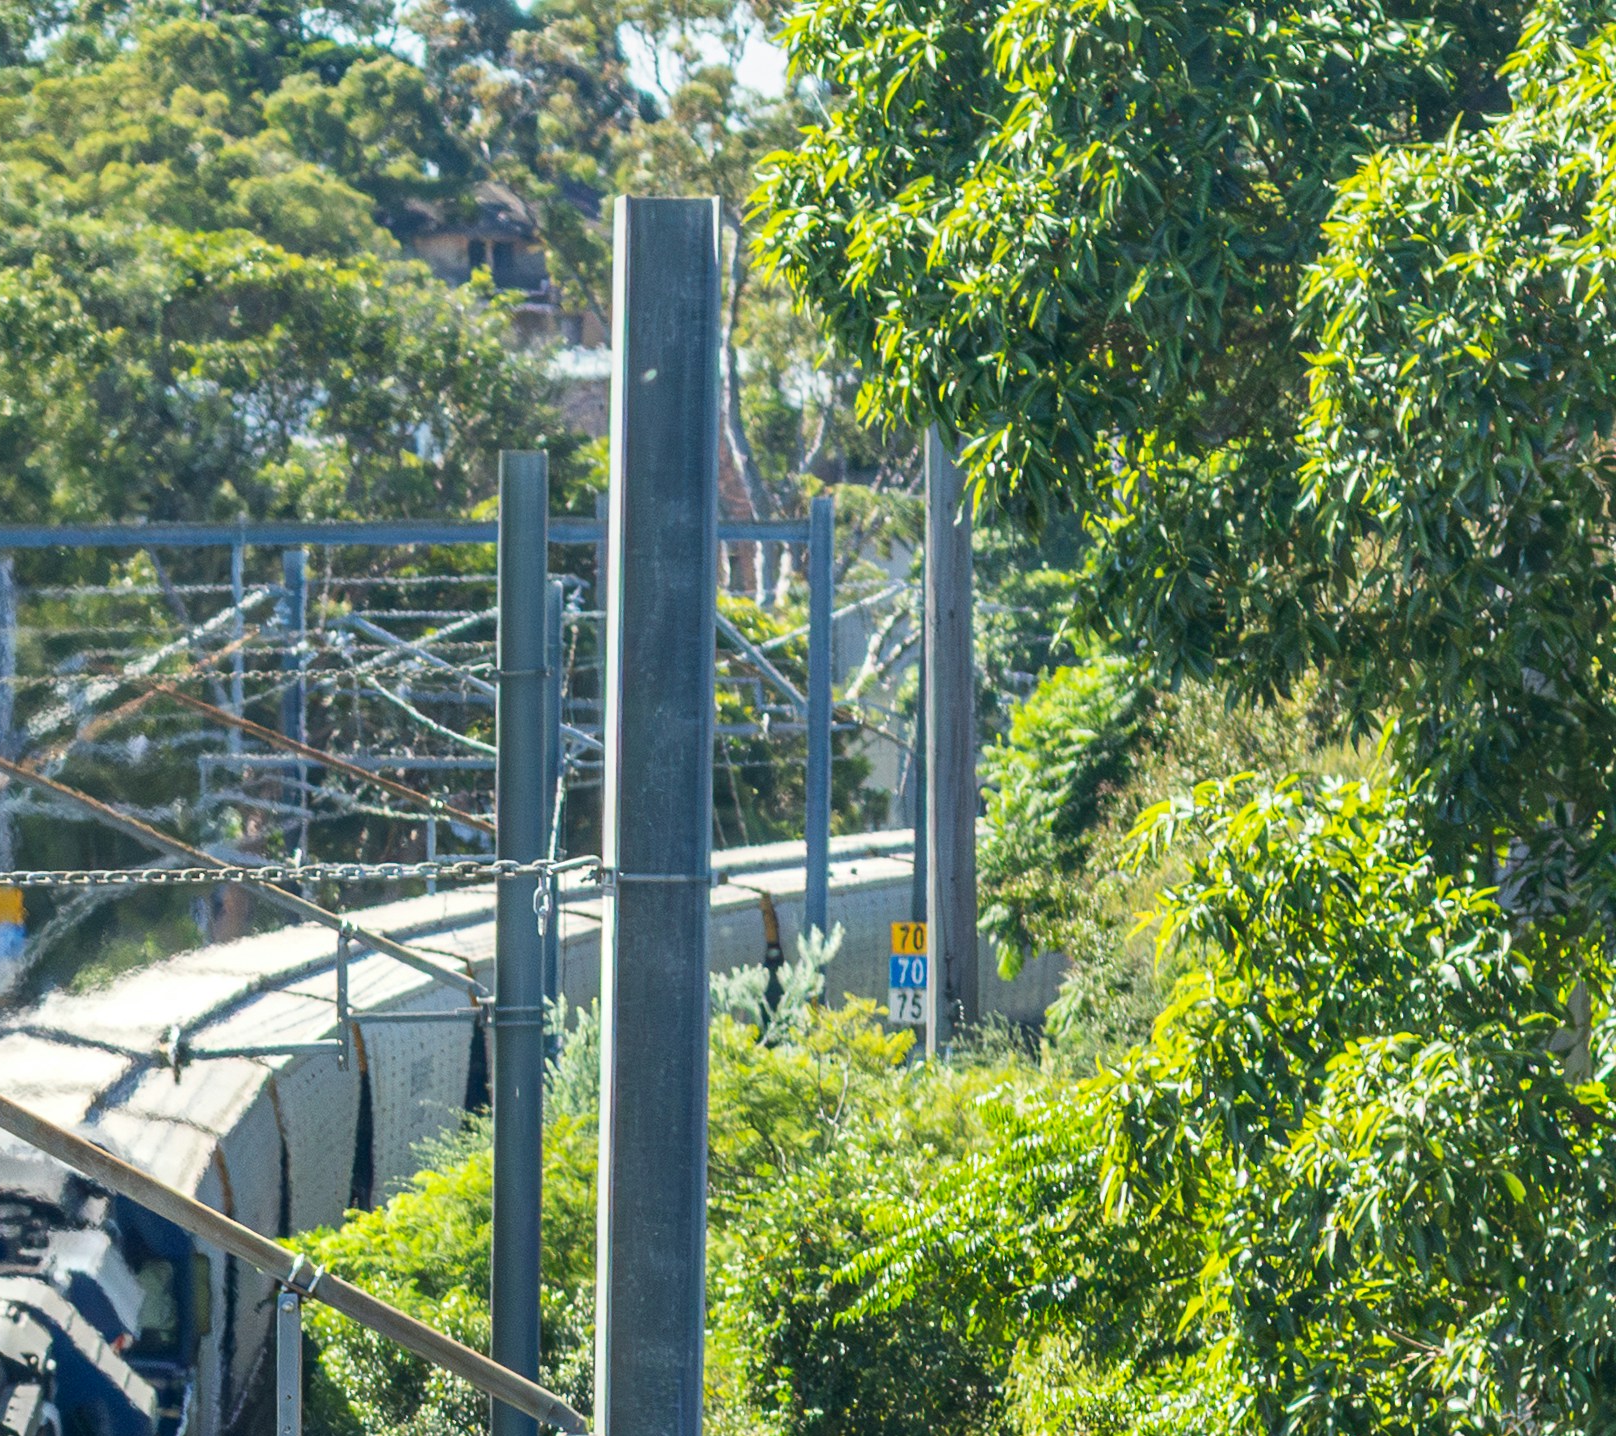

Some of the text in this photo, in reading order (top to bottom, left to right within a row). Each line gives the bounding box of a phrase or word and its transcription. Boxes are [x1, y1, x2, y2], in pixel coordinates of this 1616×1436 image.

[900, 925, 925, 951] 70
[898, 957, 925, 985] 70
[897, 993, 923, 1020] 75
